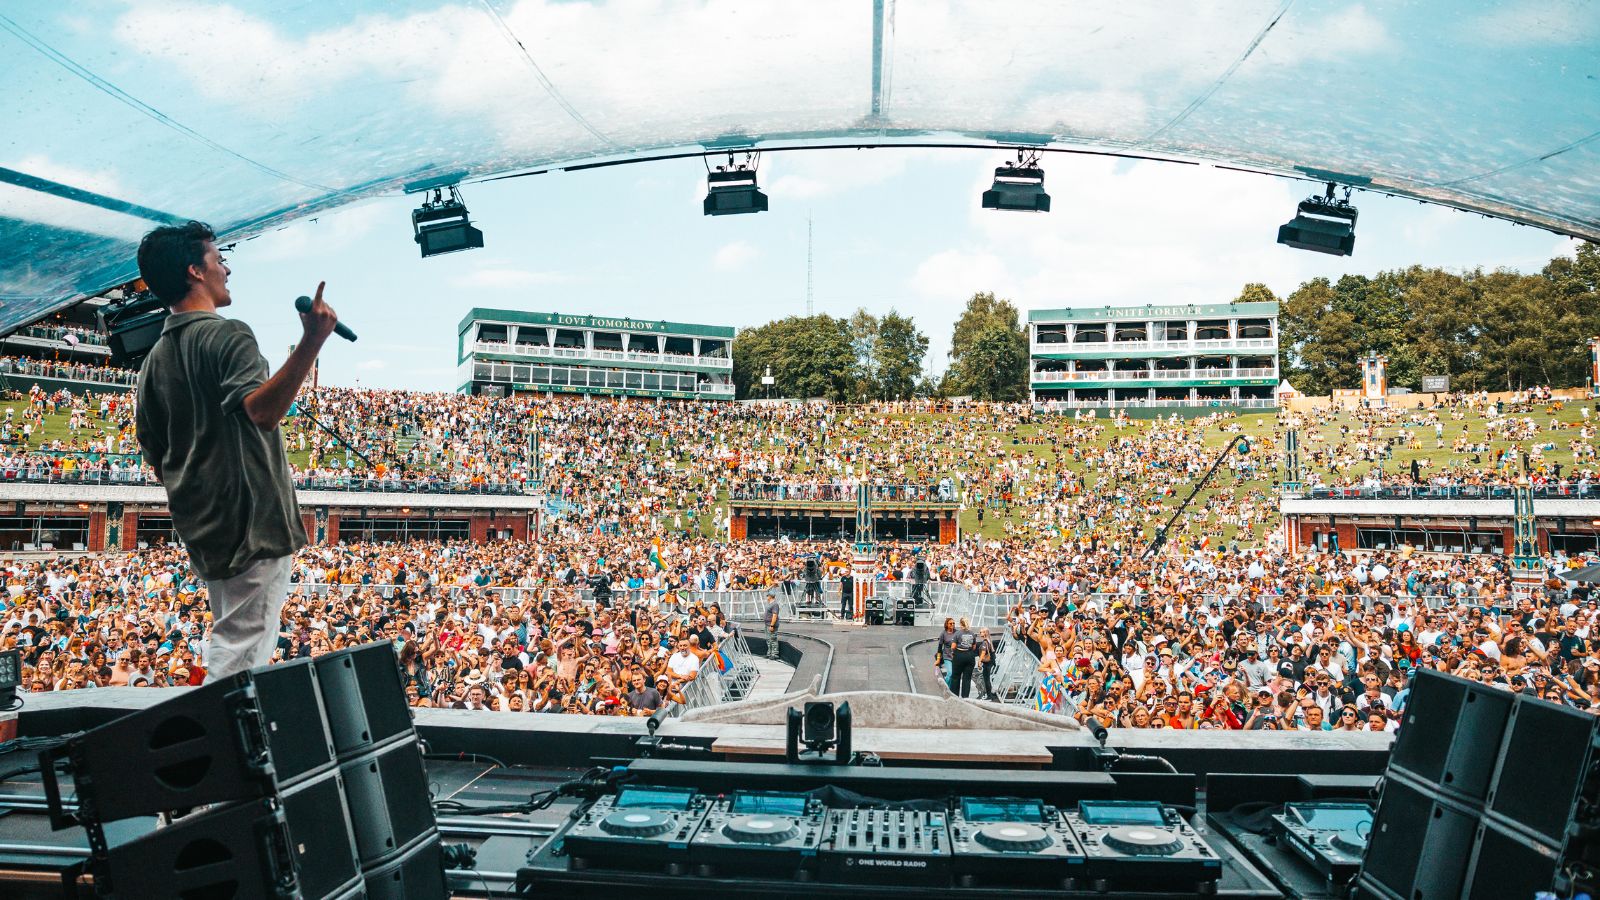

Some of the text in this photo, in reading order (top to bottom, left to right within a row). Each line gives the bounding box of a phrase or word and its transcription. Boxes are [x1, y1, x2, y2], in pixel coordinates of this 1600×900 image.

[1107, 308, 1144, 317] UNITE
[558, 316, 654, 329] LOVE TOMORROW
